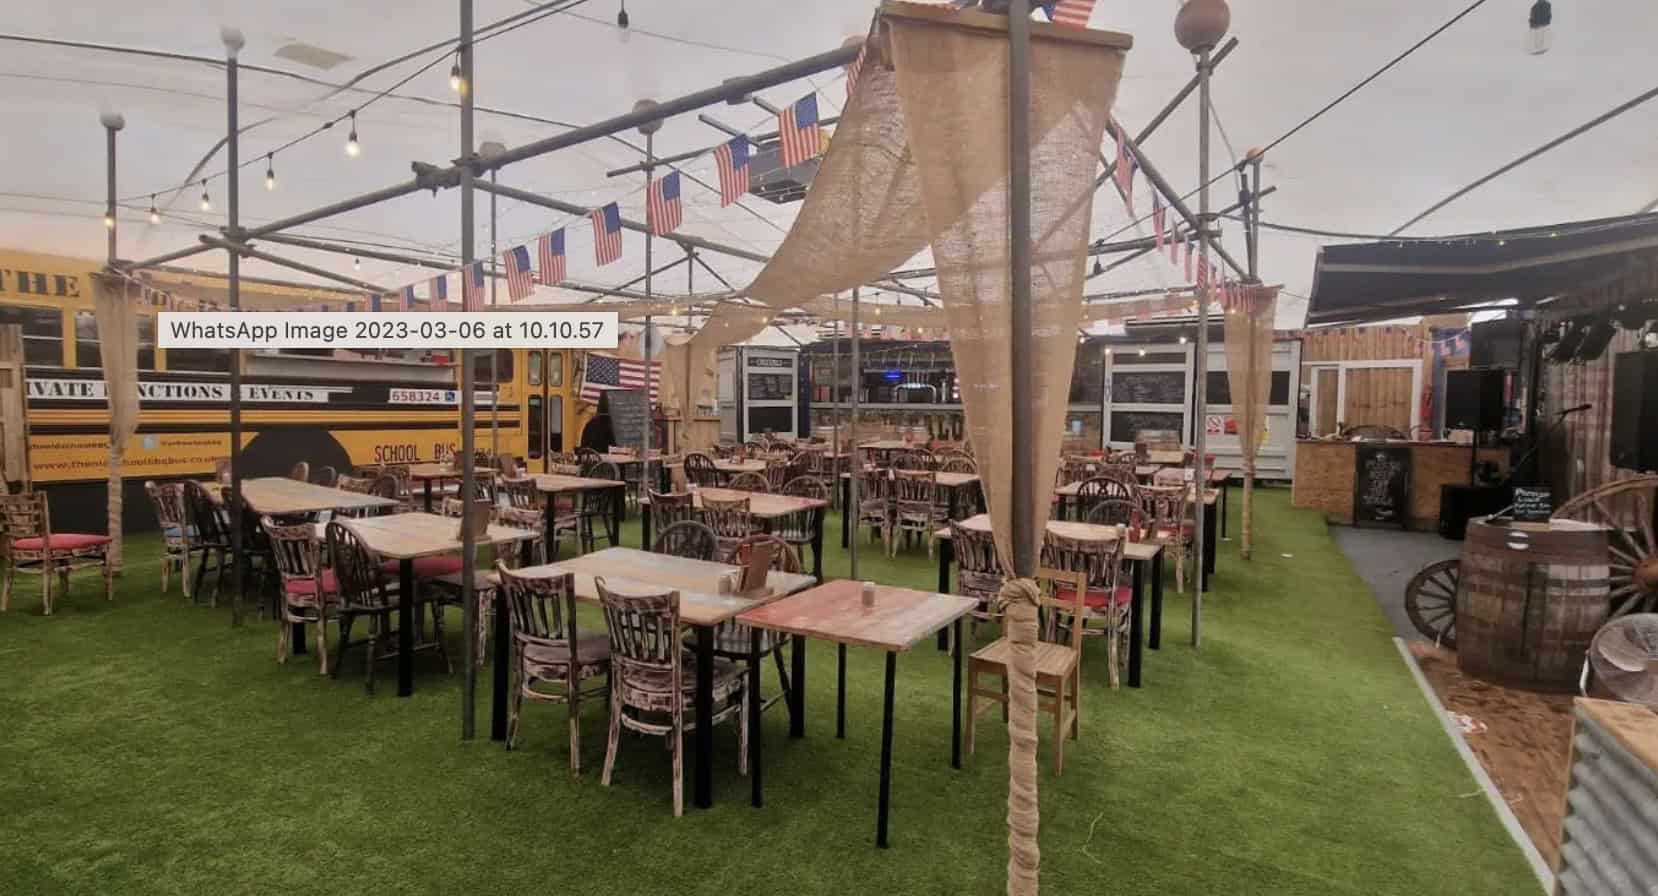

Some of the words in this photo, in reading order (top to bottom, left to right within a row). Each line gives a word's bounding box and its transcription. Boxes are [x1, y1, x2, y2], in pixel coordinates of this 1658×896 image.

[104, 383, 223, 399] NCTIONS
[249, 387, 314, 400] EVENTS
[392, 391, 440, 401] 658324
[374, 444, 420, 463] SCHOOL
[434, 443, 456, 460] BUS
